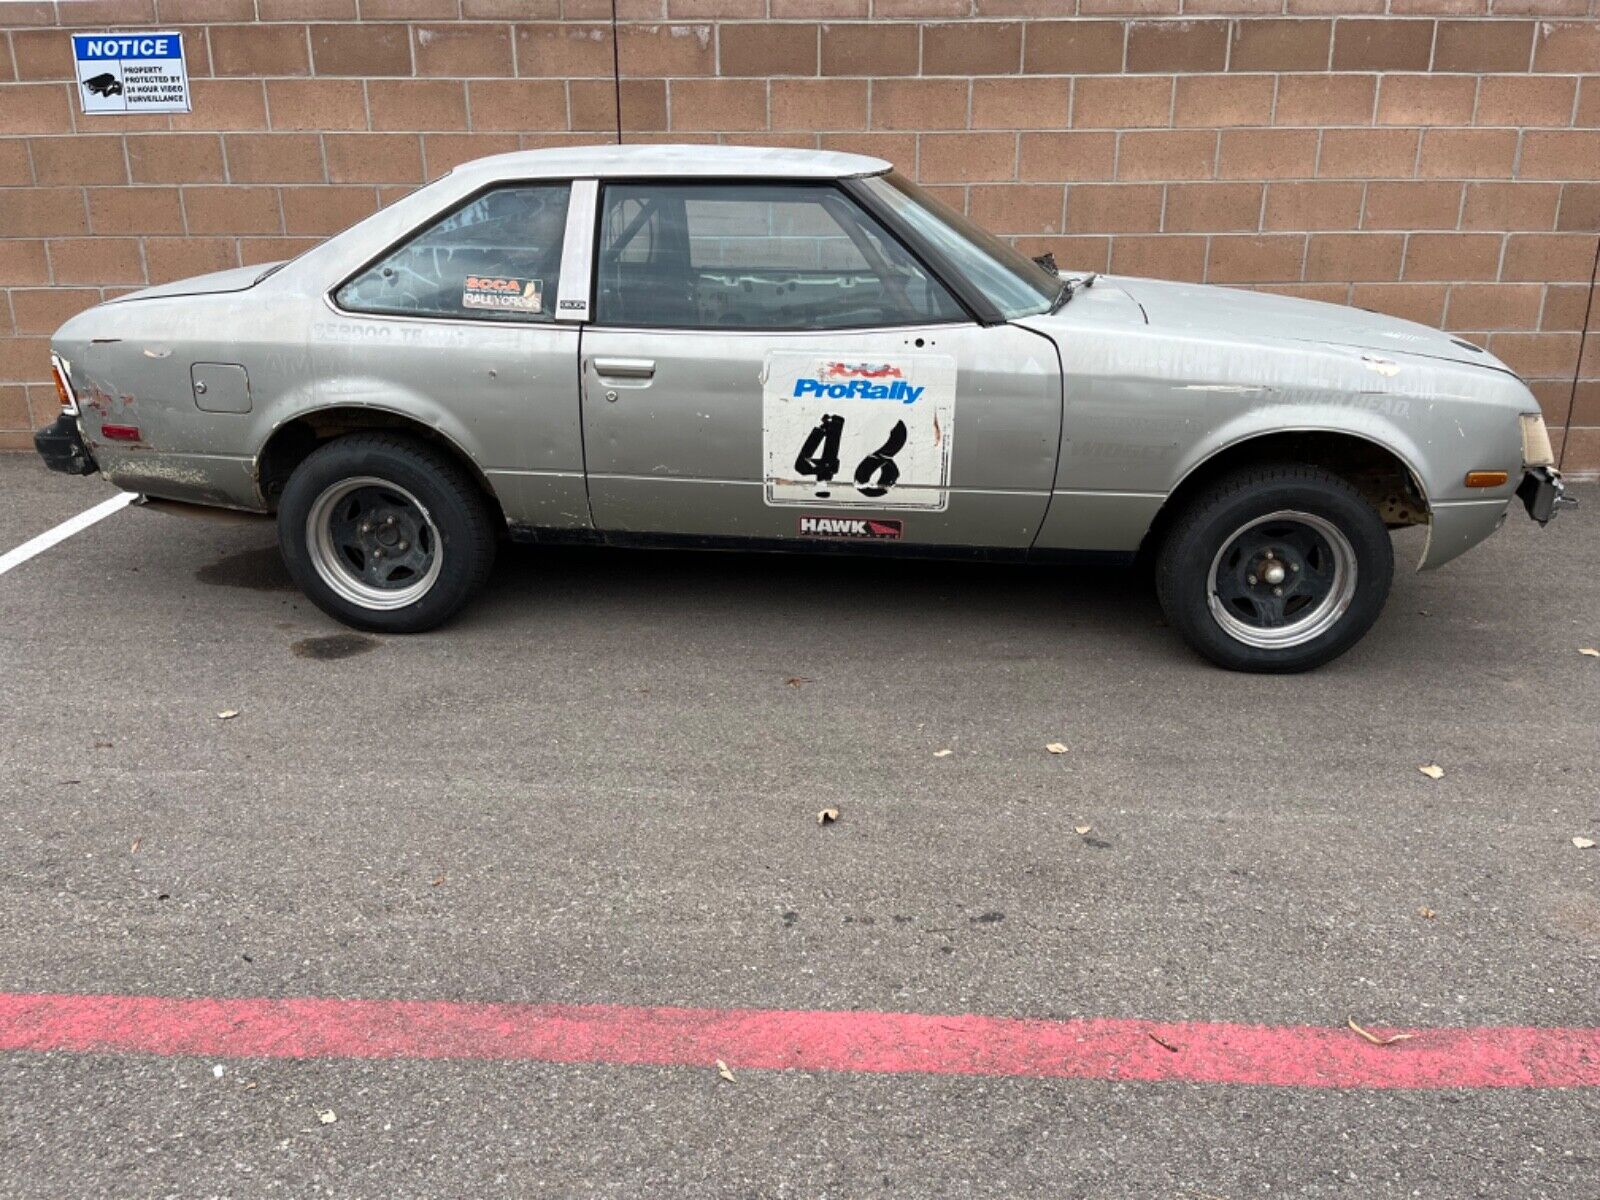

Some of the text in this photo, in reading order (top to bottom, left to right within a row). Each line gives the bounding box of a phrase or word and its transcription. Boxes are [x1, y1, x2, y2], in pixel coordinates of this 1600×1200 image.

[87, 39, 168, 56] NOTICE
[124, 66, 162, 74] PROPERTY
[125, 76, 168, 84] PROTECTED
[160, 85, 183, 93] VIDEO
[128, 95, 184, 103] SURVEILLANCE
[793, 379, 925, 404] ProRally
[795, 414, 907, 498] 46
[801, 518, 868, 534] HAWK
